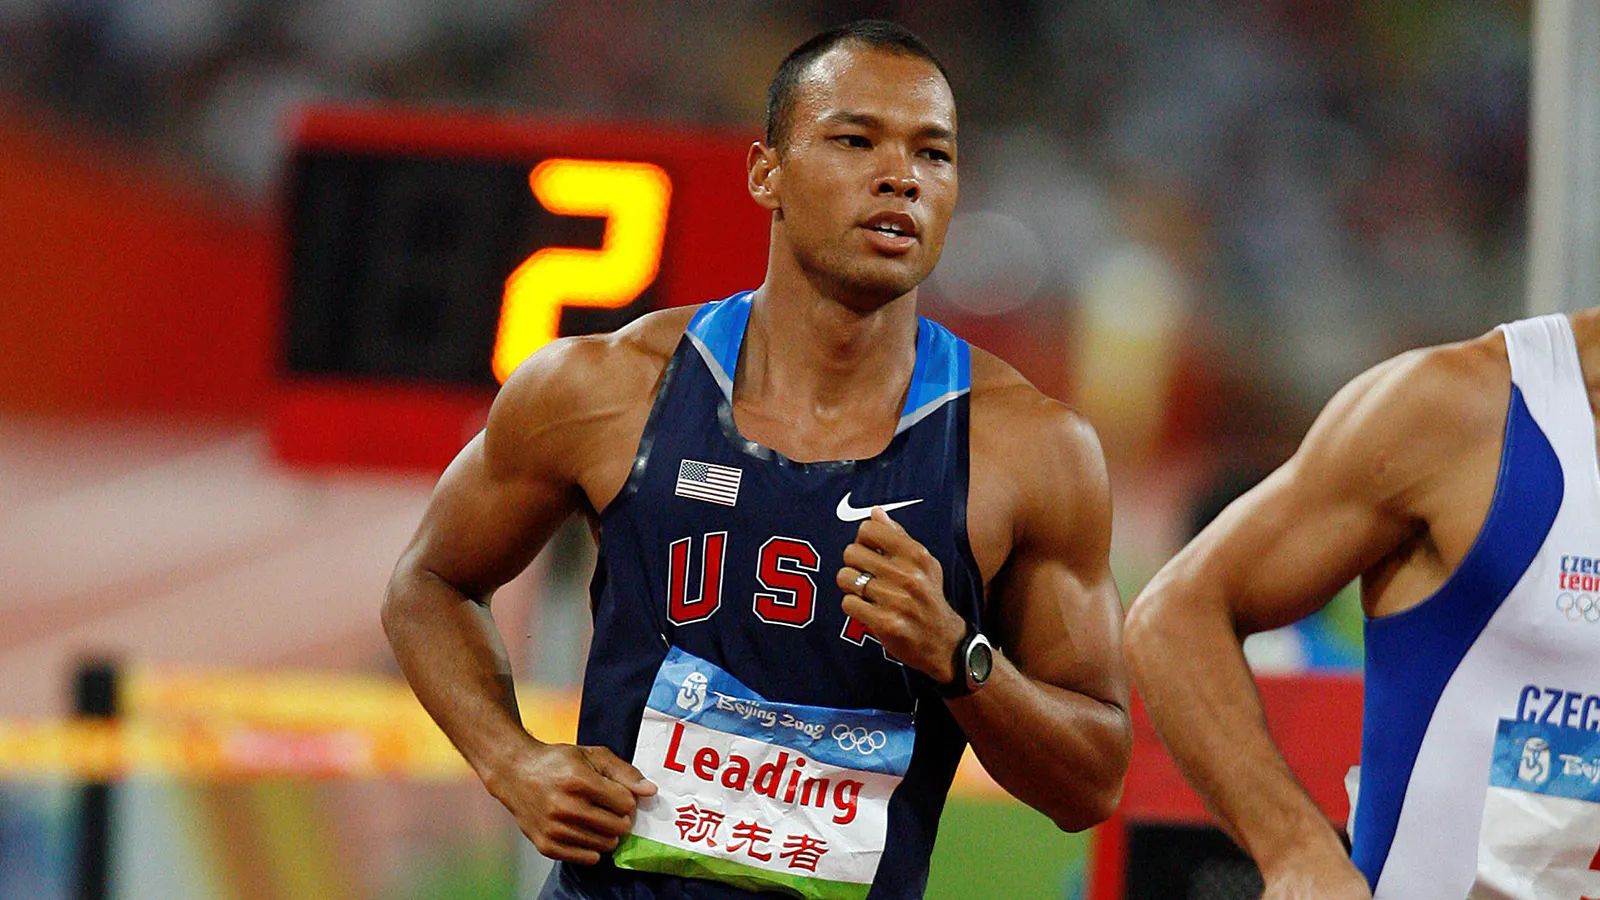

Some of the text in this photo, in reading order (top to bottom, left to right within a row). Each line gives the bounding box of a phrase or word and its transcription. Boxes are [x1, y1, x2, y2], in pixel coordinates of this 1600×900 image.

[492, 158, 673, 385] 2
[713, 691, 826, 739] Beijing 2008
[663, 721, 864, 825] Leading
[675, 803, 829, 872] 领先者
